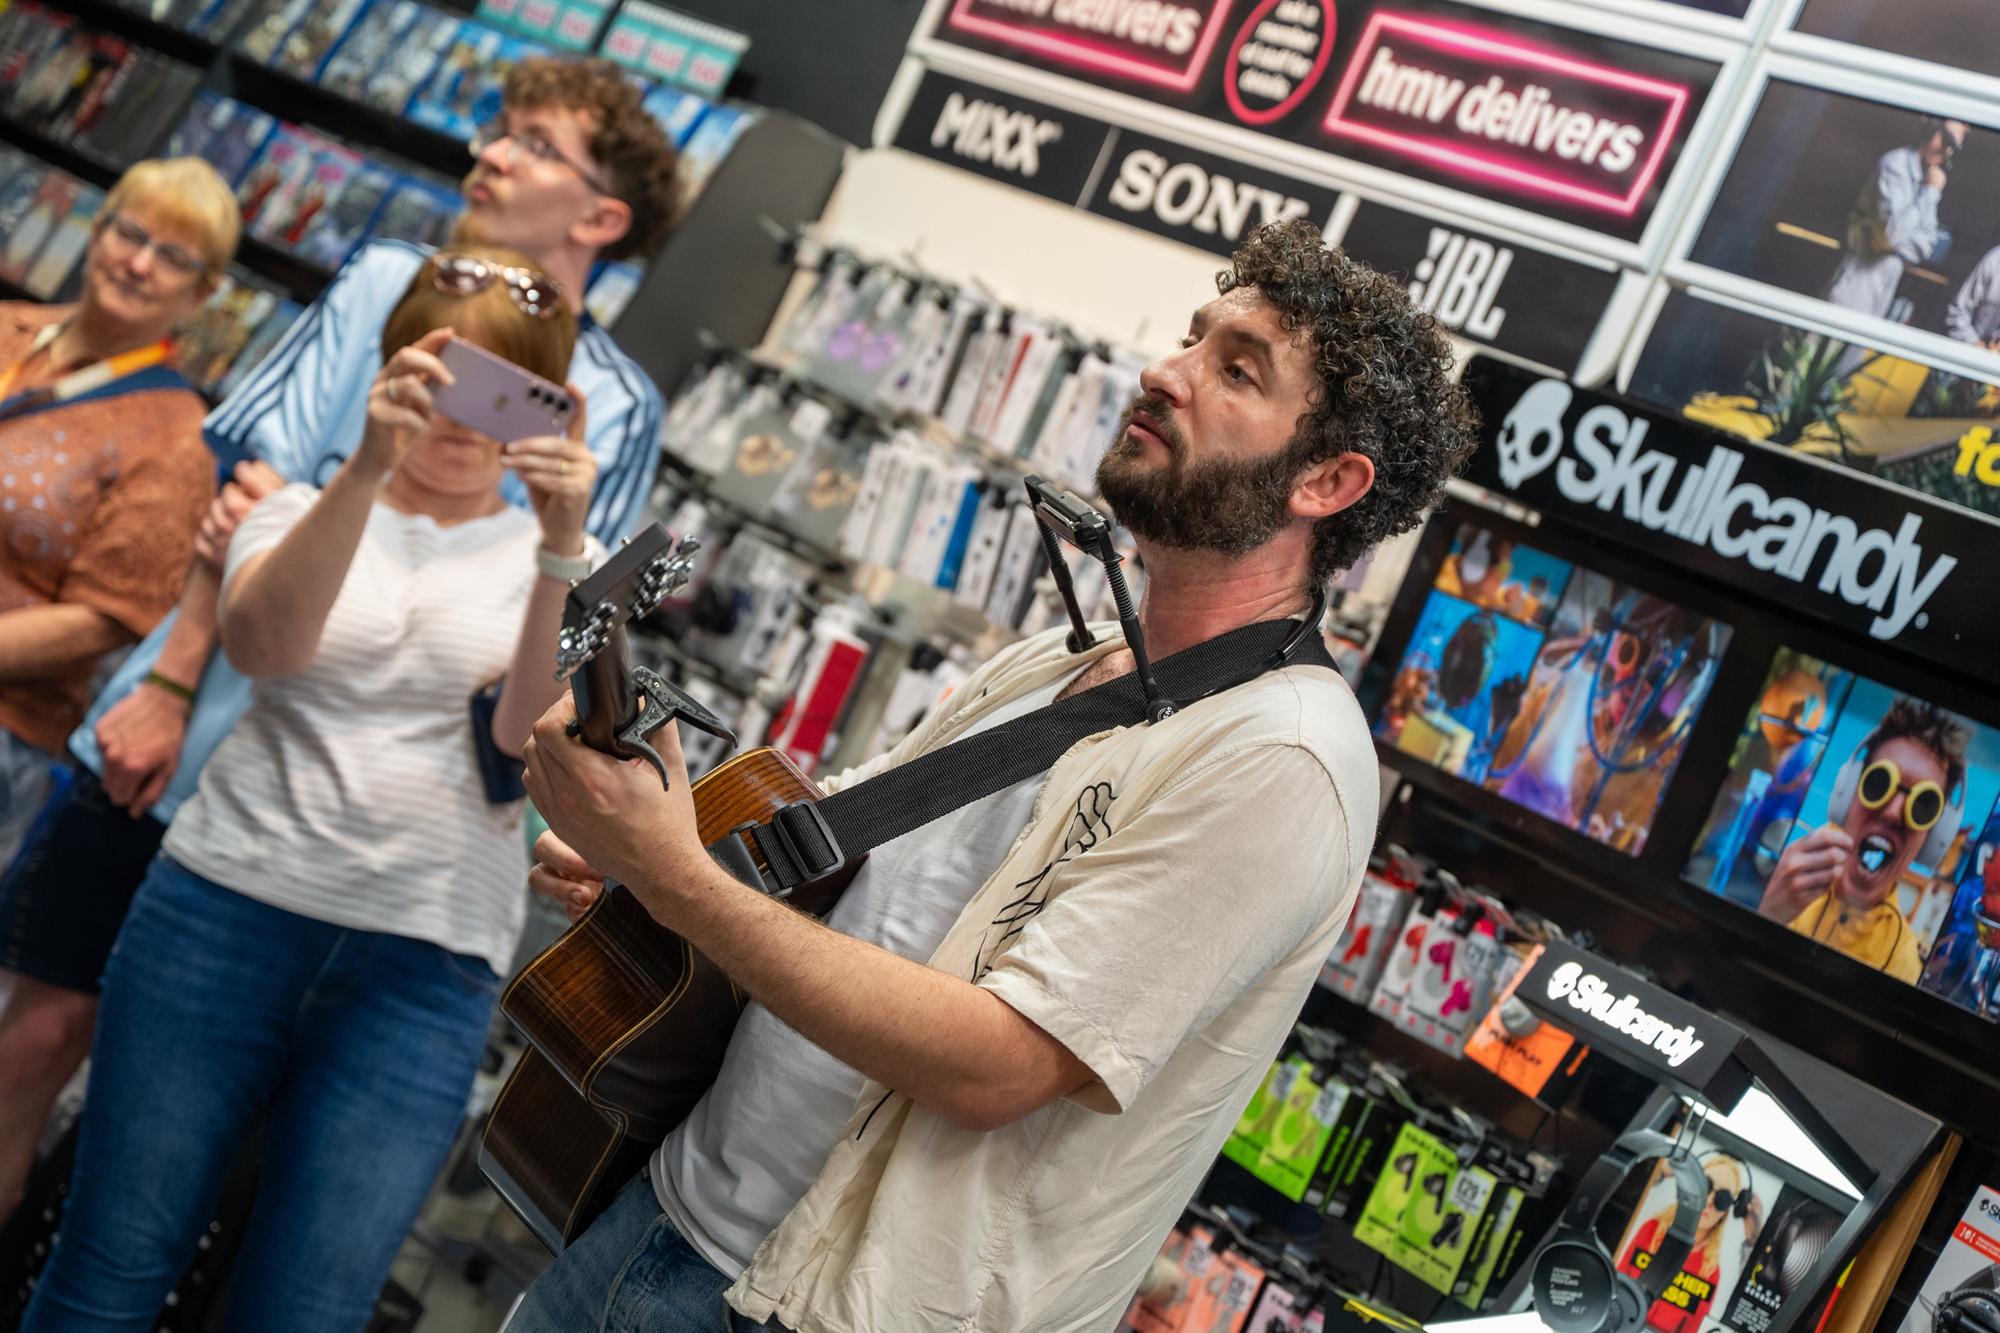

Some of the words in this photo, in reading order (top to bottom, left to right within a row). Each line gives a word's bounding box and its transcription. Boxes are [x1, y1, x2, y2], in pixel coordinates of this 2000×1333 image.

[930, 92, 1043, 177] MIXX
[1357, 46, 1466, 123] hmv
[1455, 75, 1645, 173] delivers
[1408, 228, 1514, 340] JBL
[1556, 404, 1958, 640] Skullcandy
[1568, 974, 1704, 1067] Skullcandy
[1636, 1252, 1711, 1300] CHER
